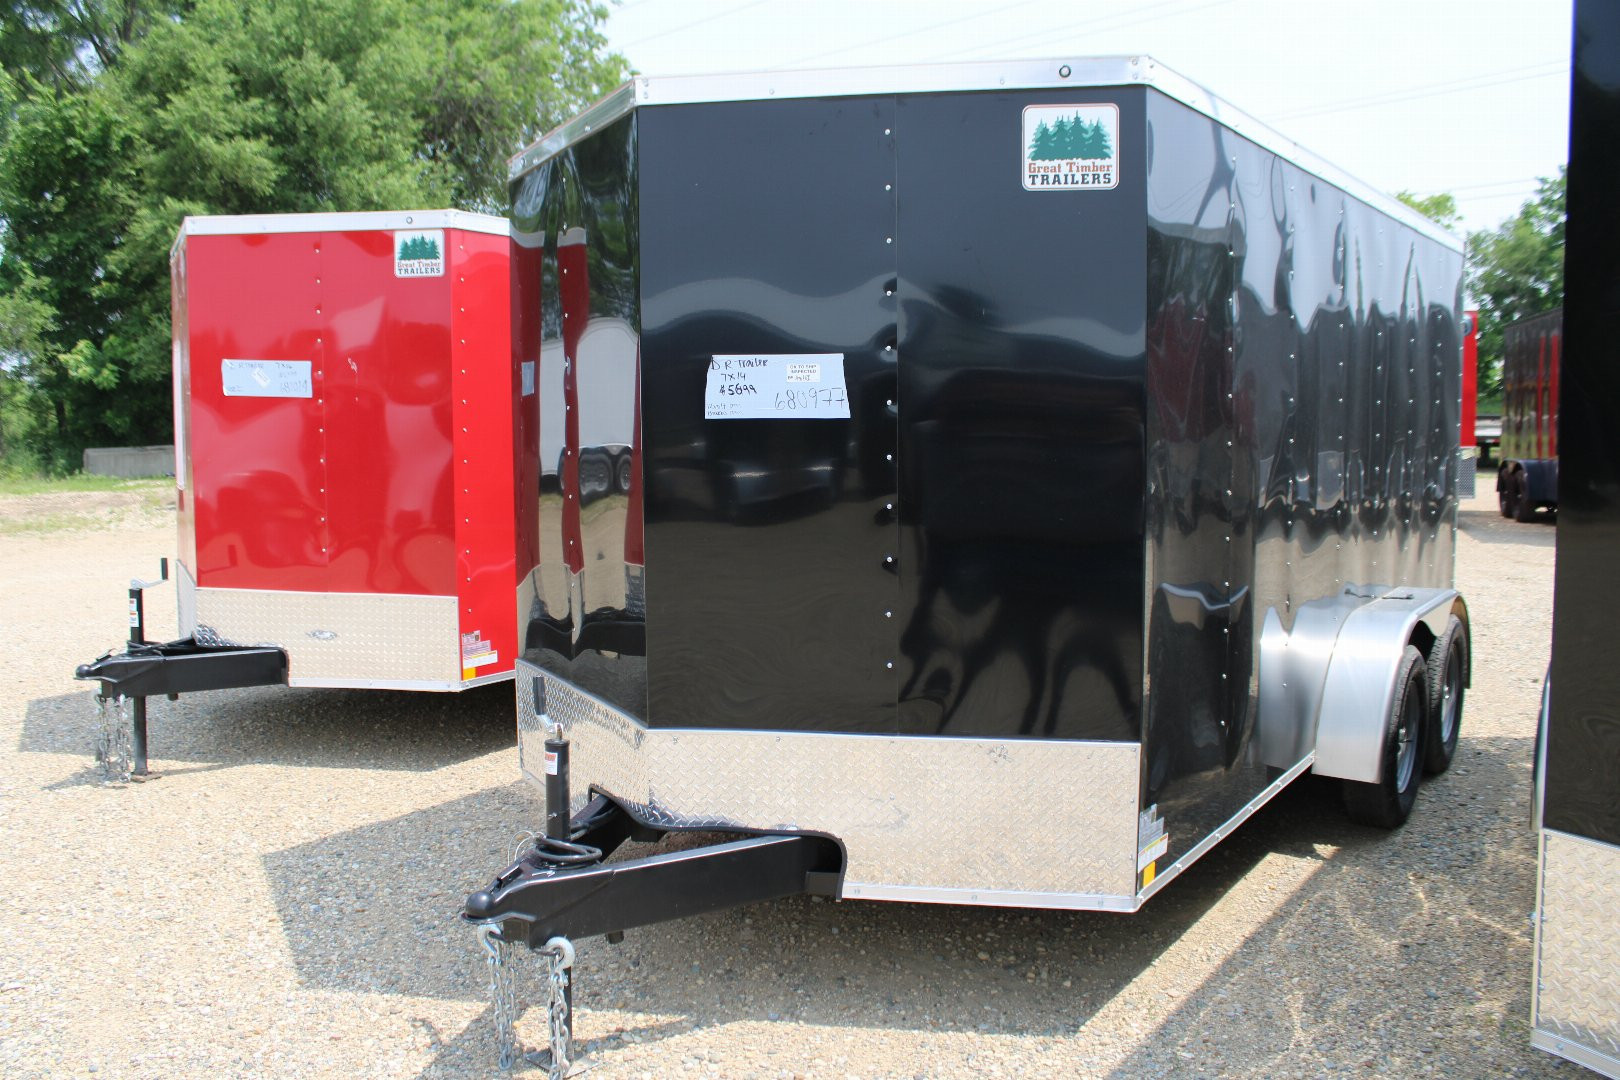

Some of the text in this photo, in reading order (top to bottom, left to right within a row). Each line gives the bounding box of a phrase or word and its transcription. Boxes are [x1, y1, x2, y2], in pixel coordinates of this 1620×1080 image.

[1028, 162, 1113, 174] Great Timber
[1028, 173, 1111, 186] TRAILERS
[398, 267, 441, 275] TRAILERS
[774, 387, 846, 411] 680977
